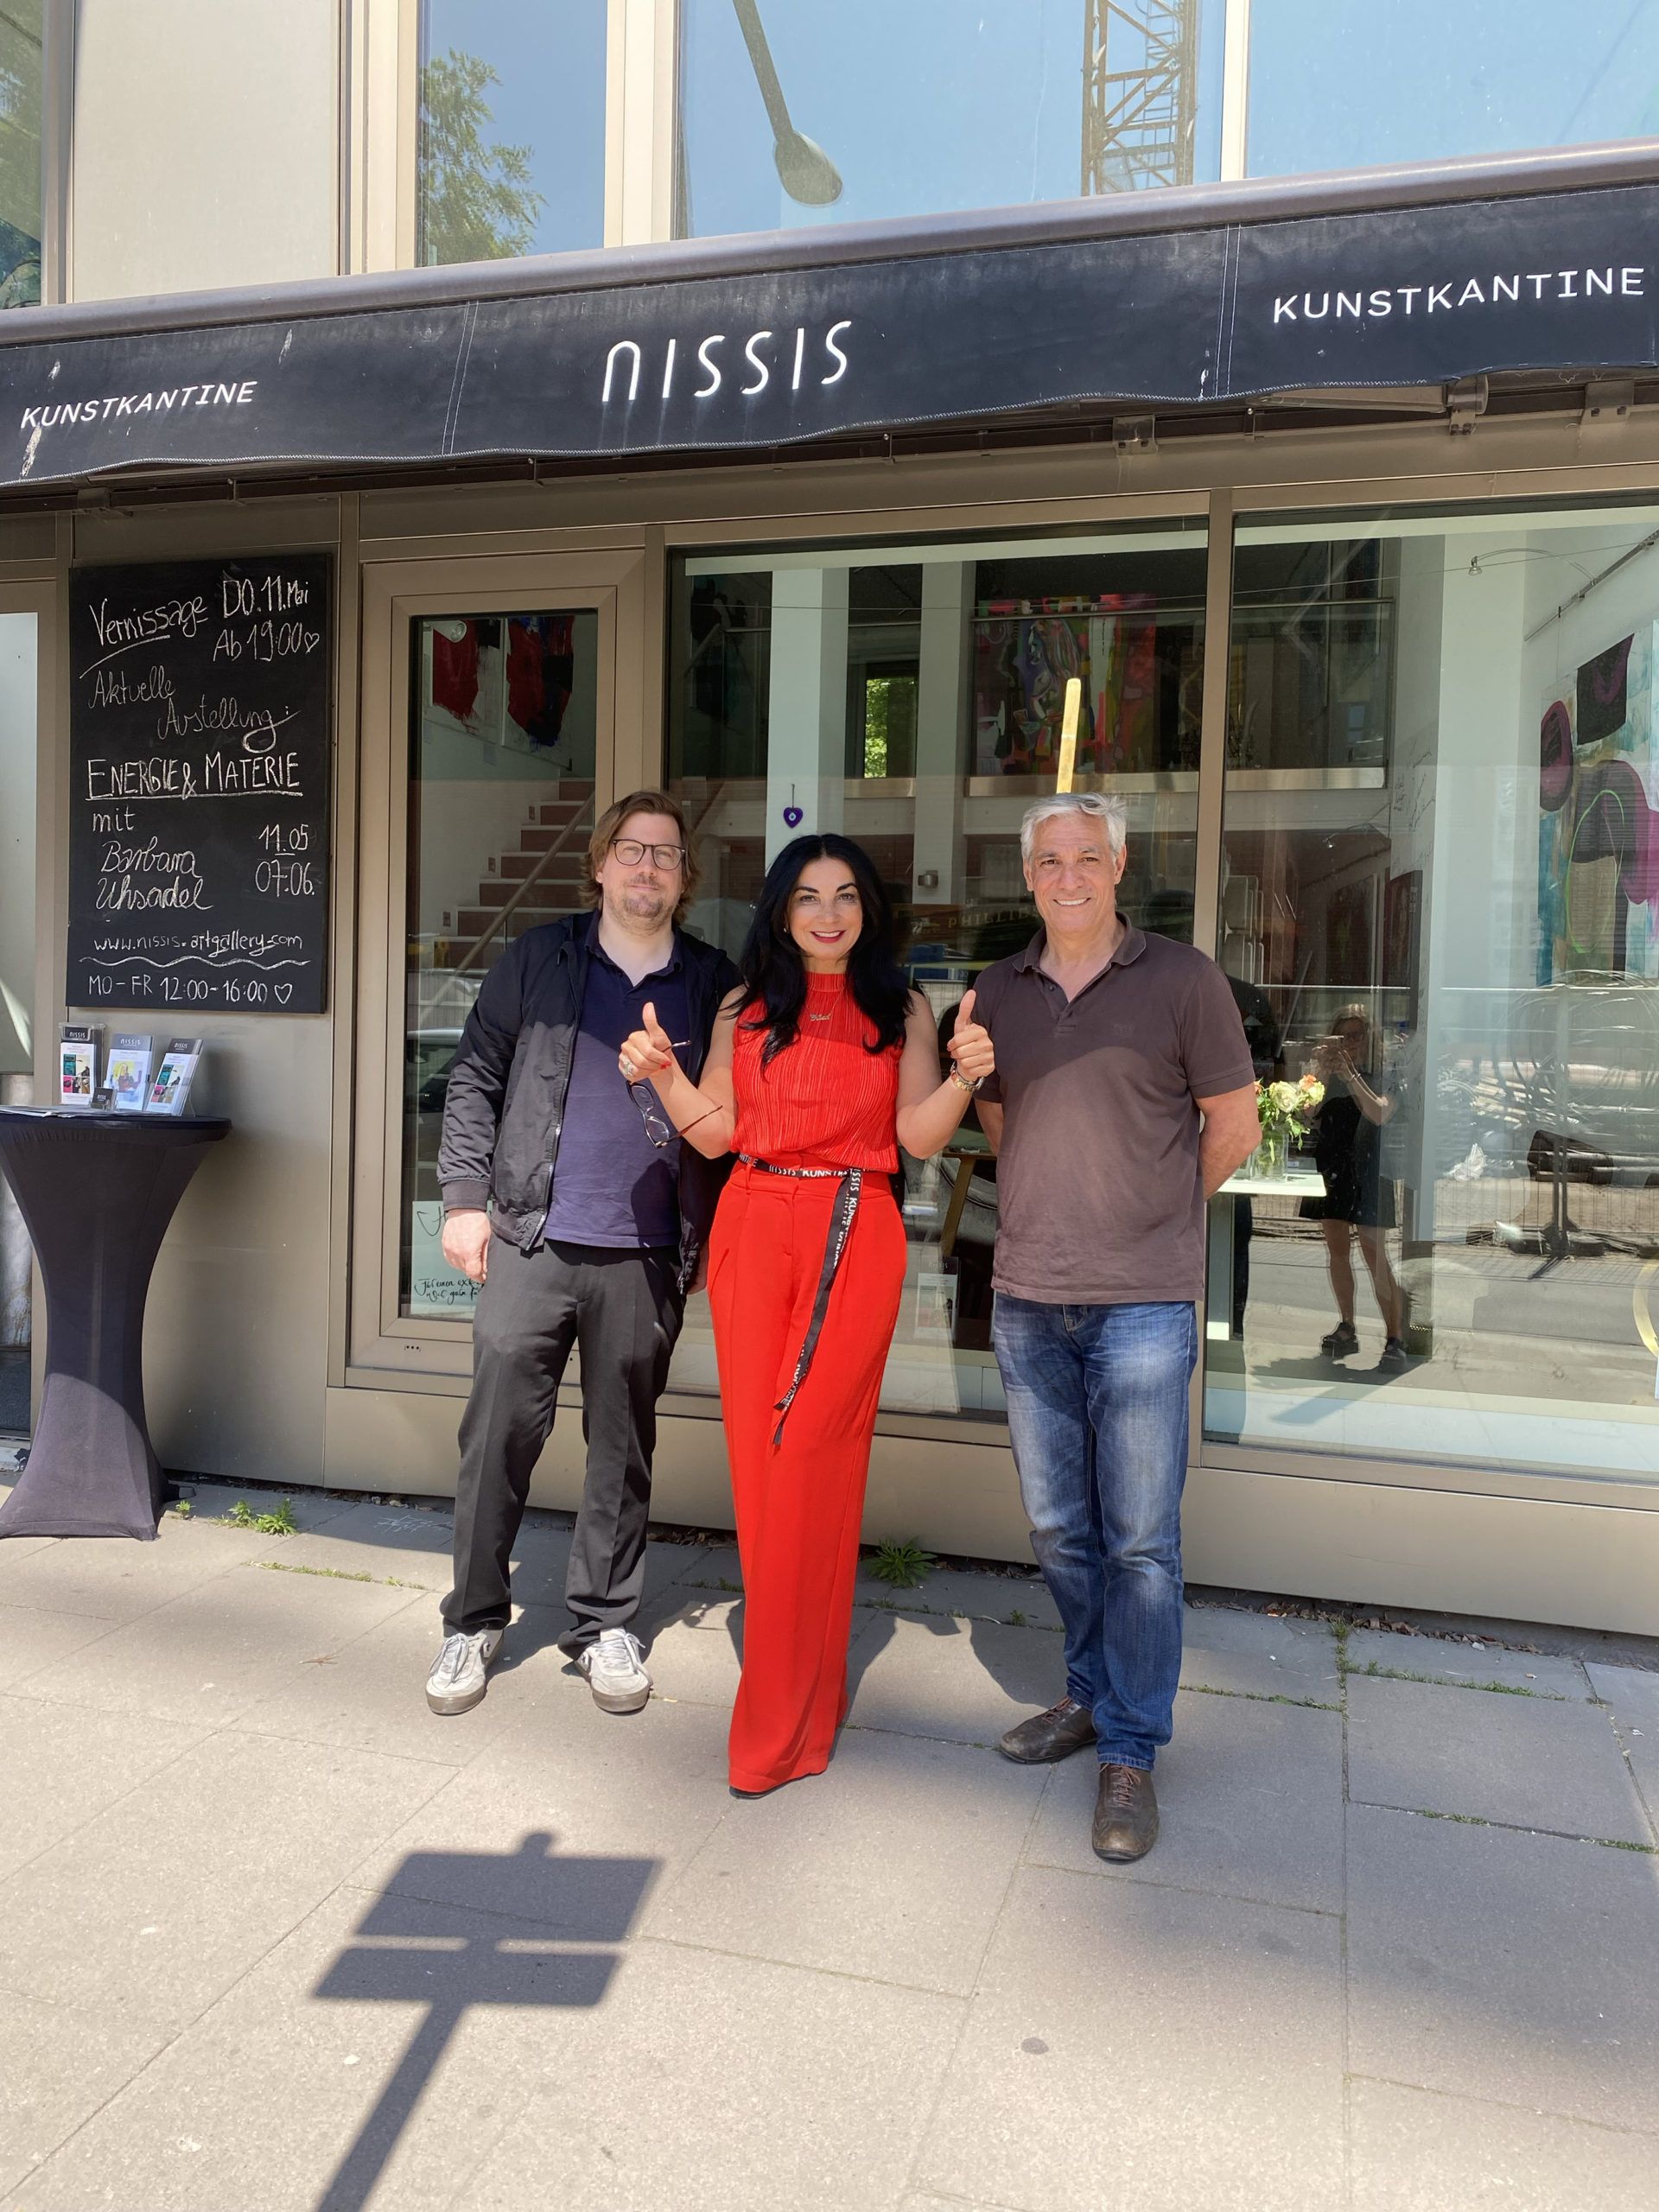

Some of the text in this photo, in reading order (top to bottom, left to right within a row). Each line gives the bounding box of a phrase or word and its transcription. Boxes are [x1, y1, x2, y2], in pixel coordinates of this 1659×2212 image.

[1274, 268, 1644, 323] KUNSTKANTINE
[602, 321, 852, 402] NISSIS
[21, 380, 257, 429] KUNSTKANTINE
[89, 597, 208, 646] Vernissage
[213, 620, 302, 662] Ab 19:00
[88, 665, 175, 709] Aktuelle
[206, 752, 300, 791] MATERIE
[92, 806, 136, 832] mit
[258, 823, 308, 852] 11.05
[101, 836, 203, 878] Barbara
